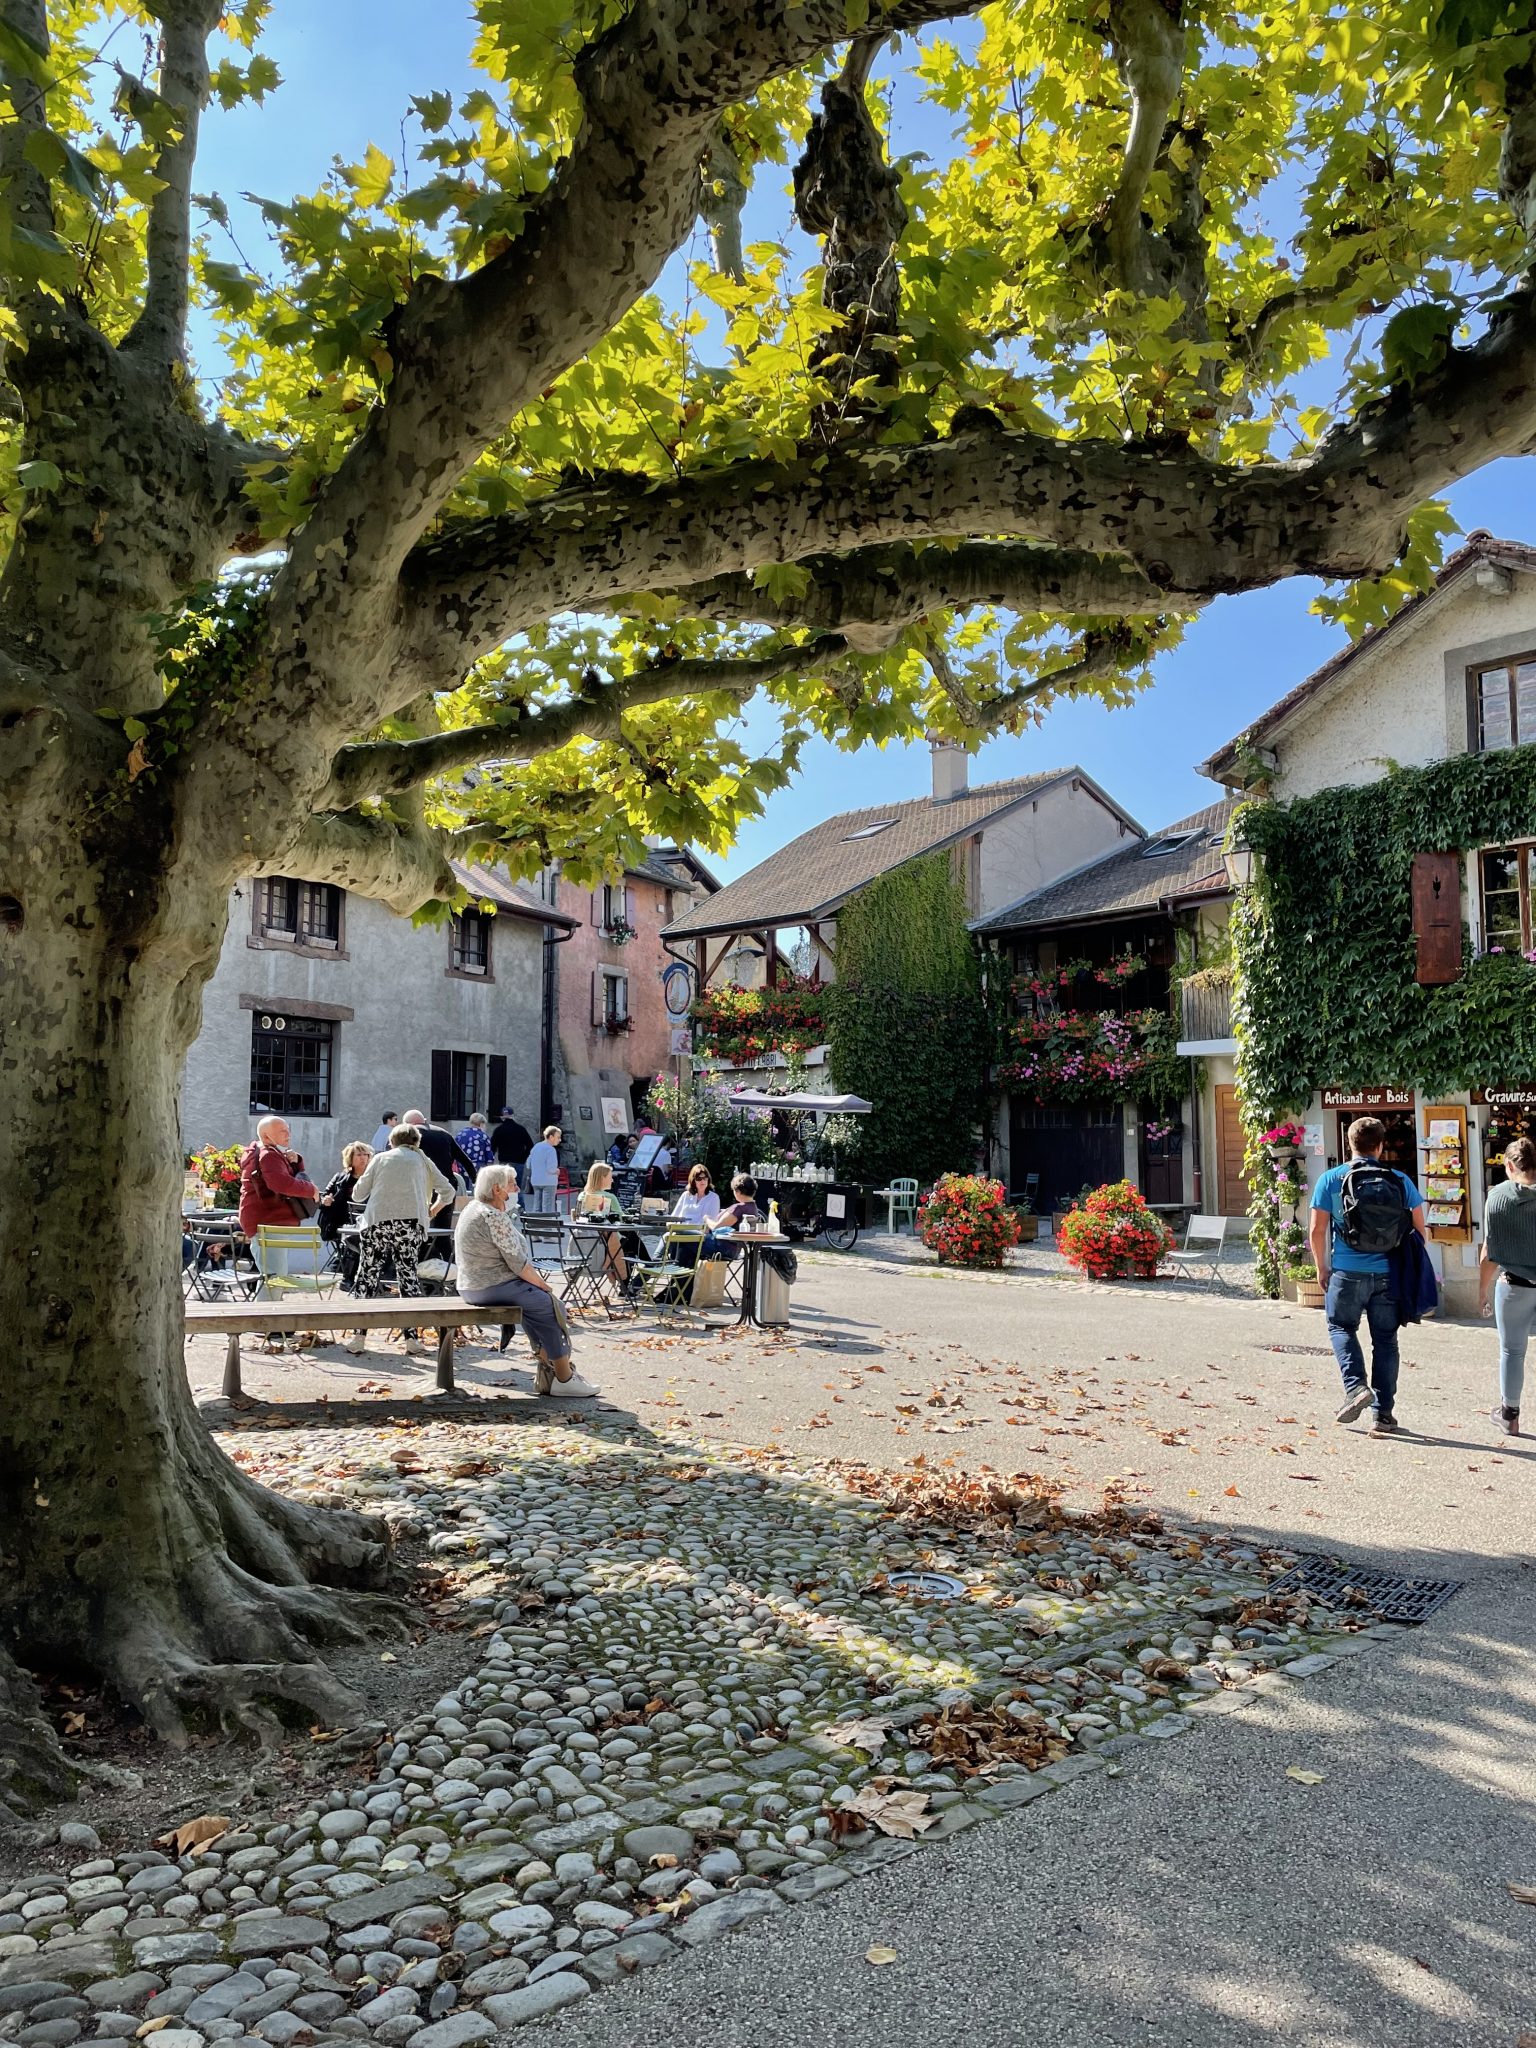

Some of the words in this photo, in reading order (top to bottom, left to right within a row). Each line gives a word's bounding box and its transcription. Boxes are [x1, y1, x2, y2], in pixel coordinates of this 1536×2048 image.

[1324, 1091, 1364, 1105] Artisanat
[1367, 1094, 1382, 1104] sur
[1386, 1089, 1409, 1103] Bois
[1484, 1087, 1526, 1103] Gravure
